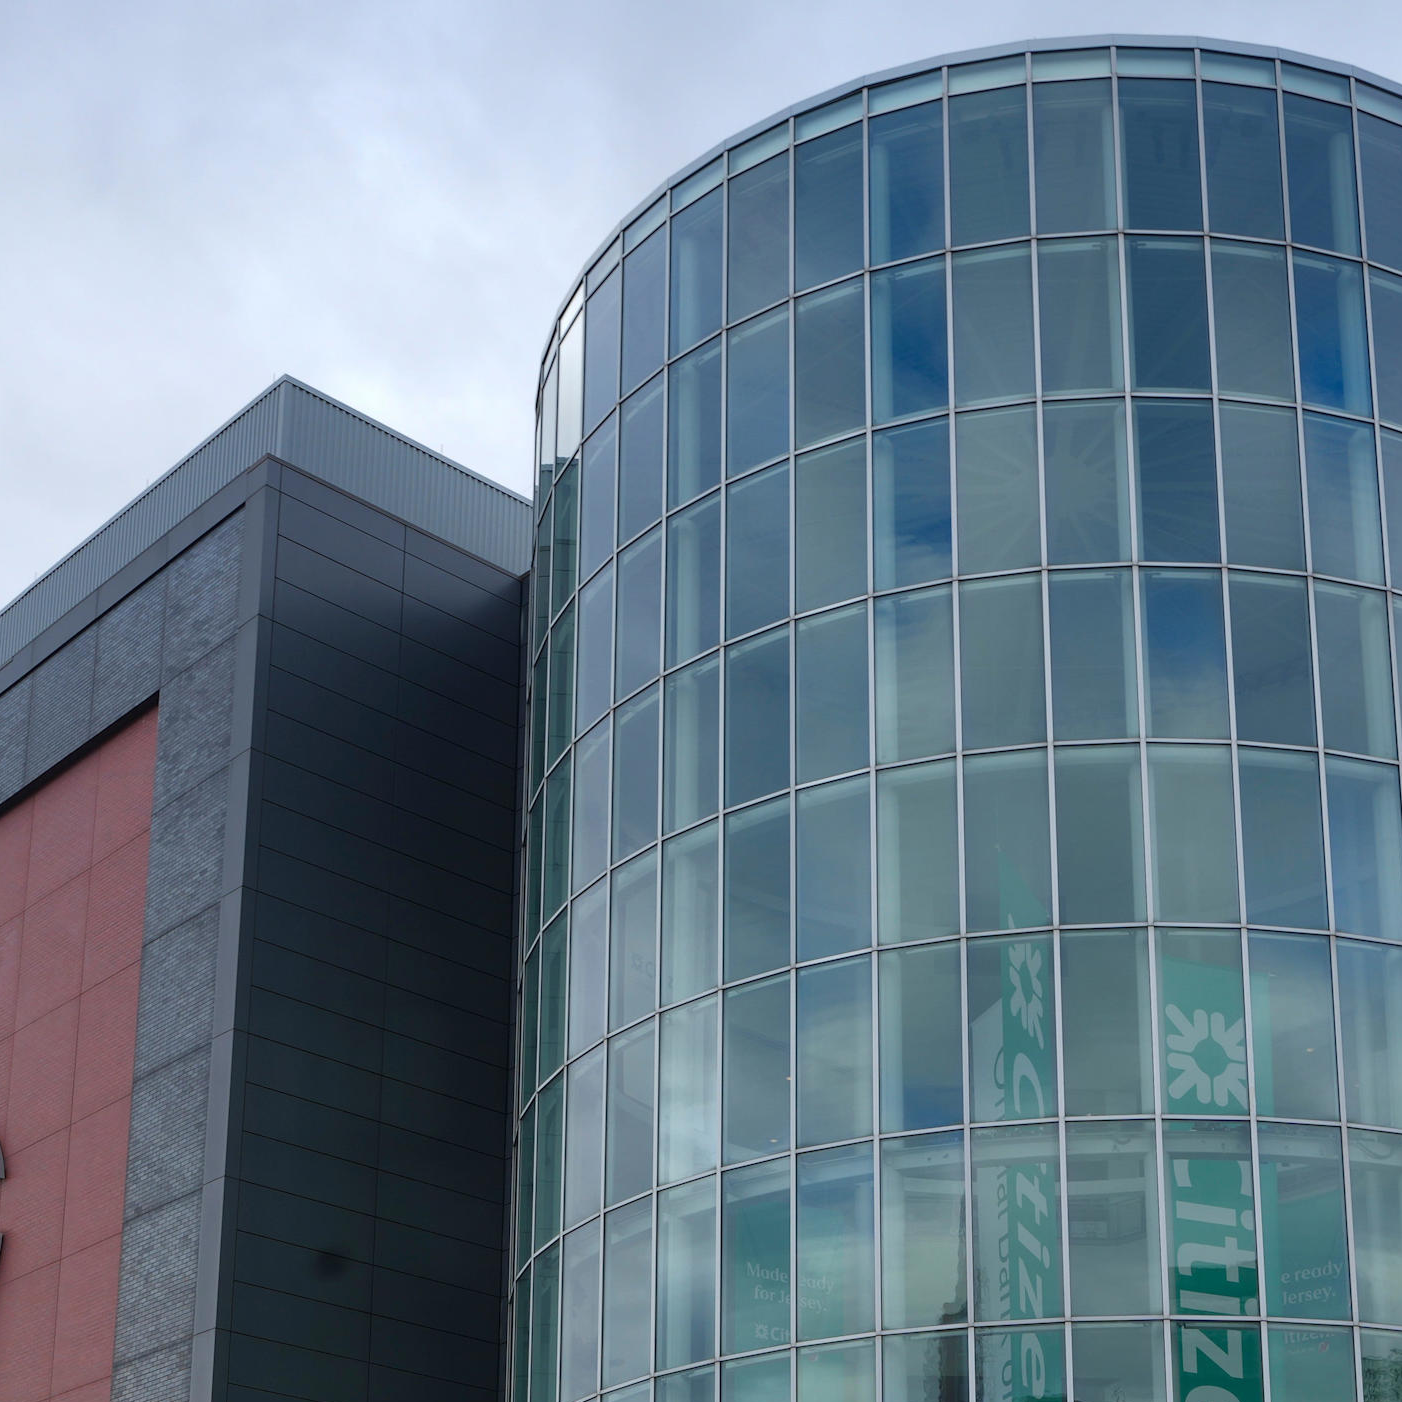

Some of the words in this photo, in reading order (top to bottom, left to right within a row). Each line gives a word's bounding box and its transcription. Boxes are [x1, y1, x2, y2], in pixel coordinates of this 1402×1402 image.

[1295, 1261, 1343, 1281] ready
[799, 1276, 835, 1294] eady
[753, 1284, 776, 1300] for
[777, 1290, 829, 1313] Jesey.
